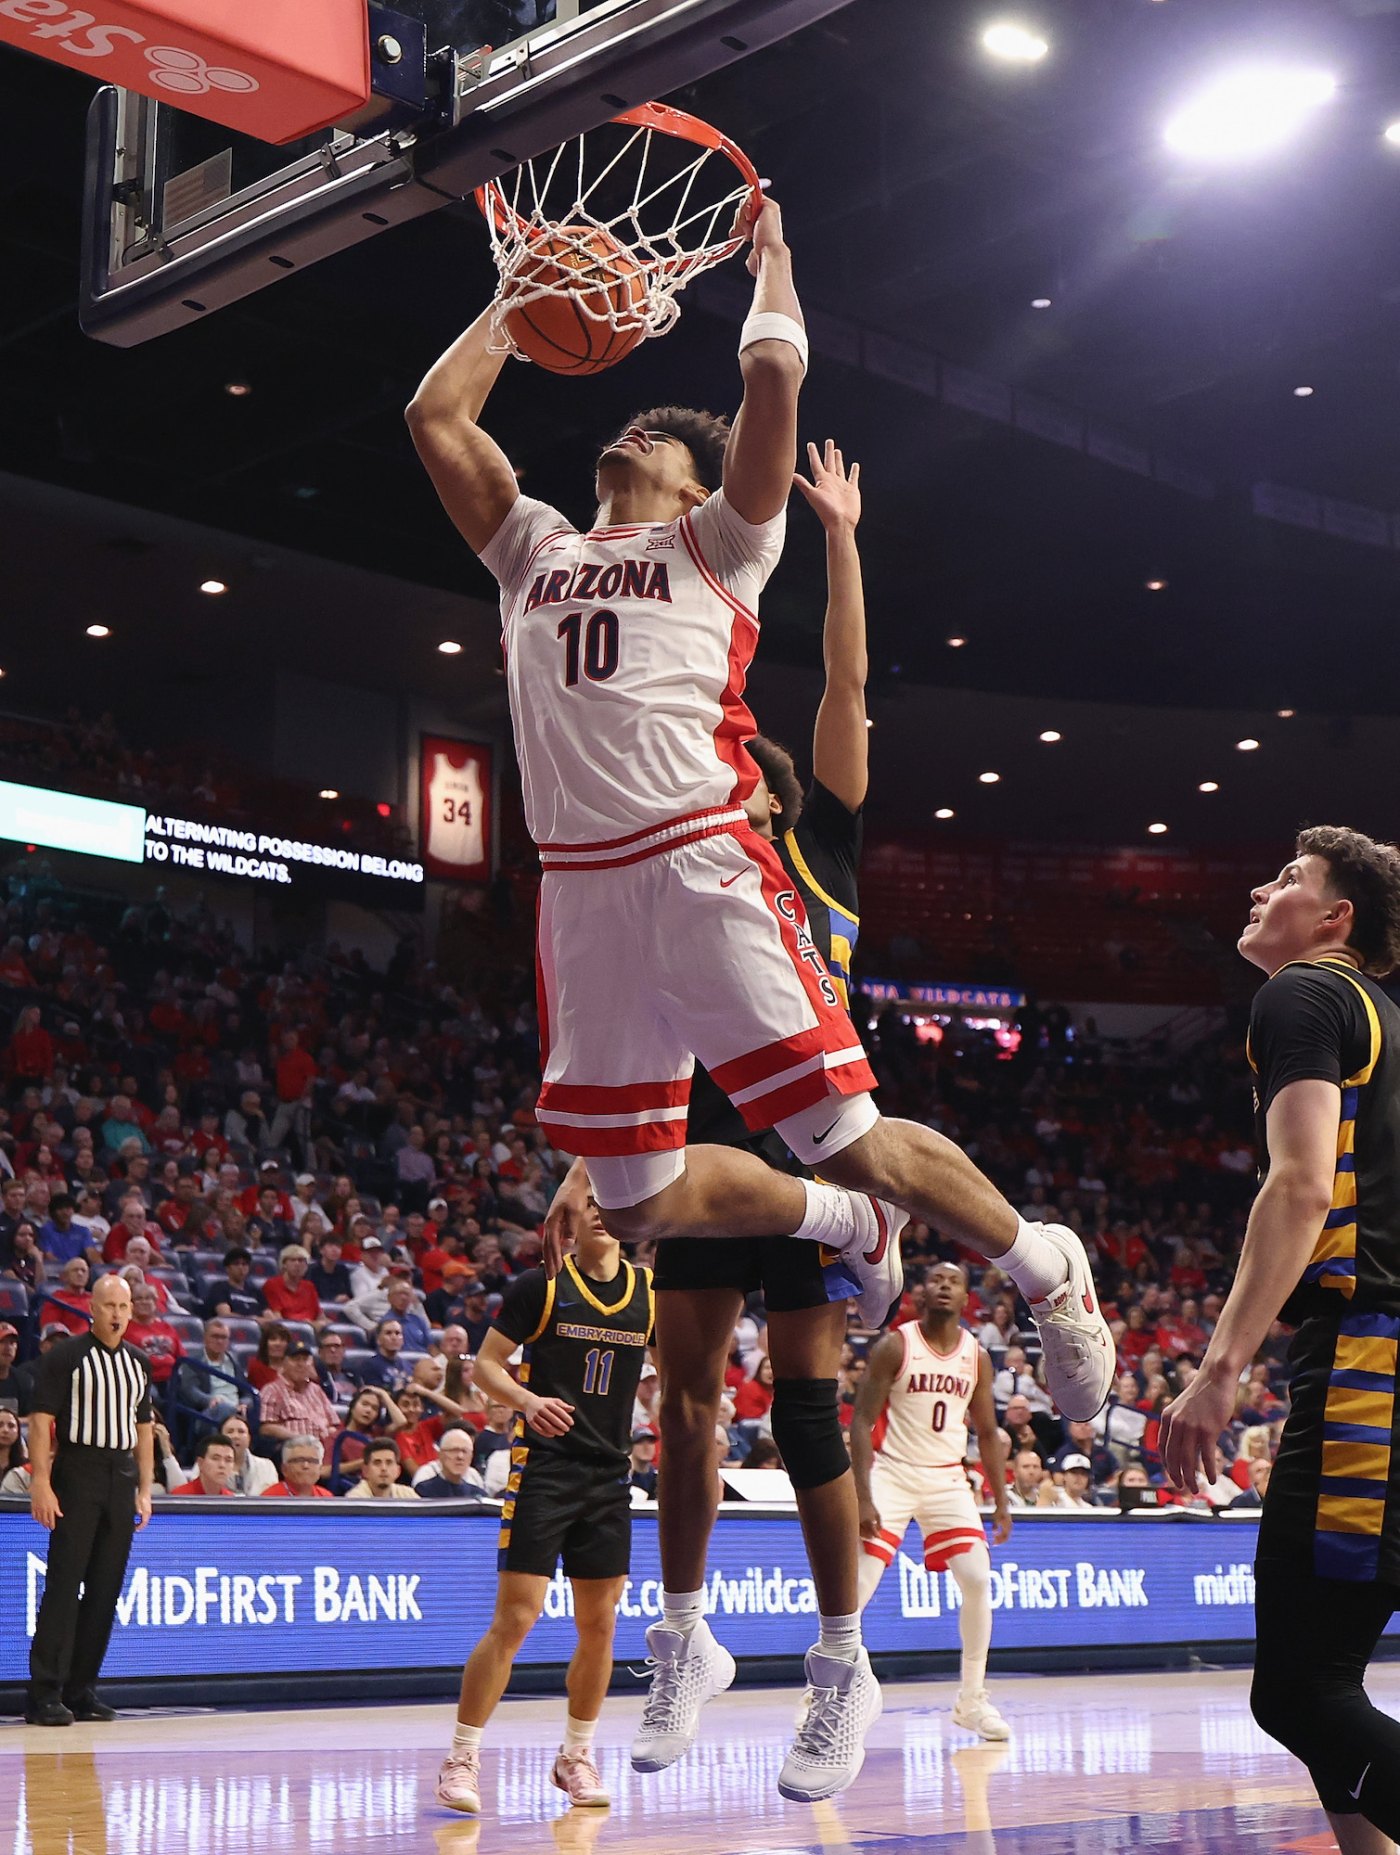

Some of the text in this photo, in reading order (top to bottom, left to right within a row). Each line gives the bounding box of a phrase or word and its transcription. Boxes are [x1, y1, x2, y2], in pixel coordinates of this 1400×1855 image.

[523, 560, 672, 617] ARIZONA
[557, 609, 619, 687] 10
[443, 798, 471, 826] 34
[145, 815, 257, 852] ALTERNATING
[258, 835, 360, 871] POSSESSION
[361, 855, 424, 883] BELONG
[145, 839, 292, 883] TO THE WILDCATS.
[774, 890, 838, 1006] CATS
[909, 987, 1011, 1007] WILDCATS
[556, 1323, 645, 1347] EMBRY-RIDDLE
[583, 1348, 614, 1396] 11
[932, 1400, 947, 1432] 0
[313, 1566, 423, 1623] BANK
[1076, 1562, 1149, 1608] BANK
